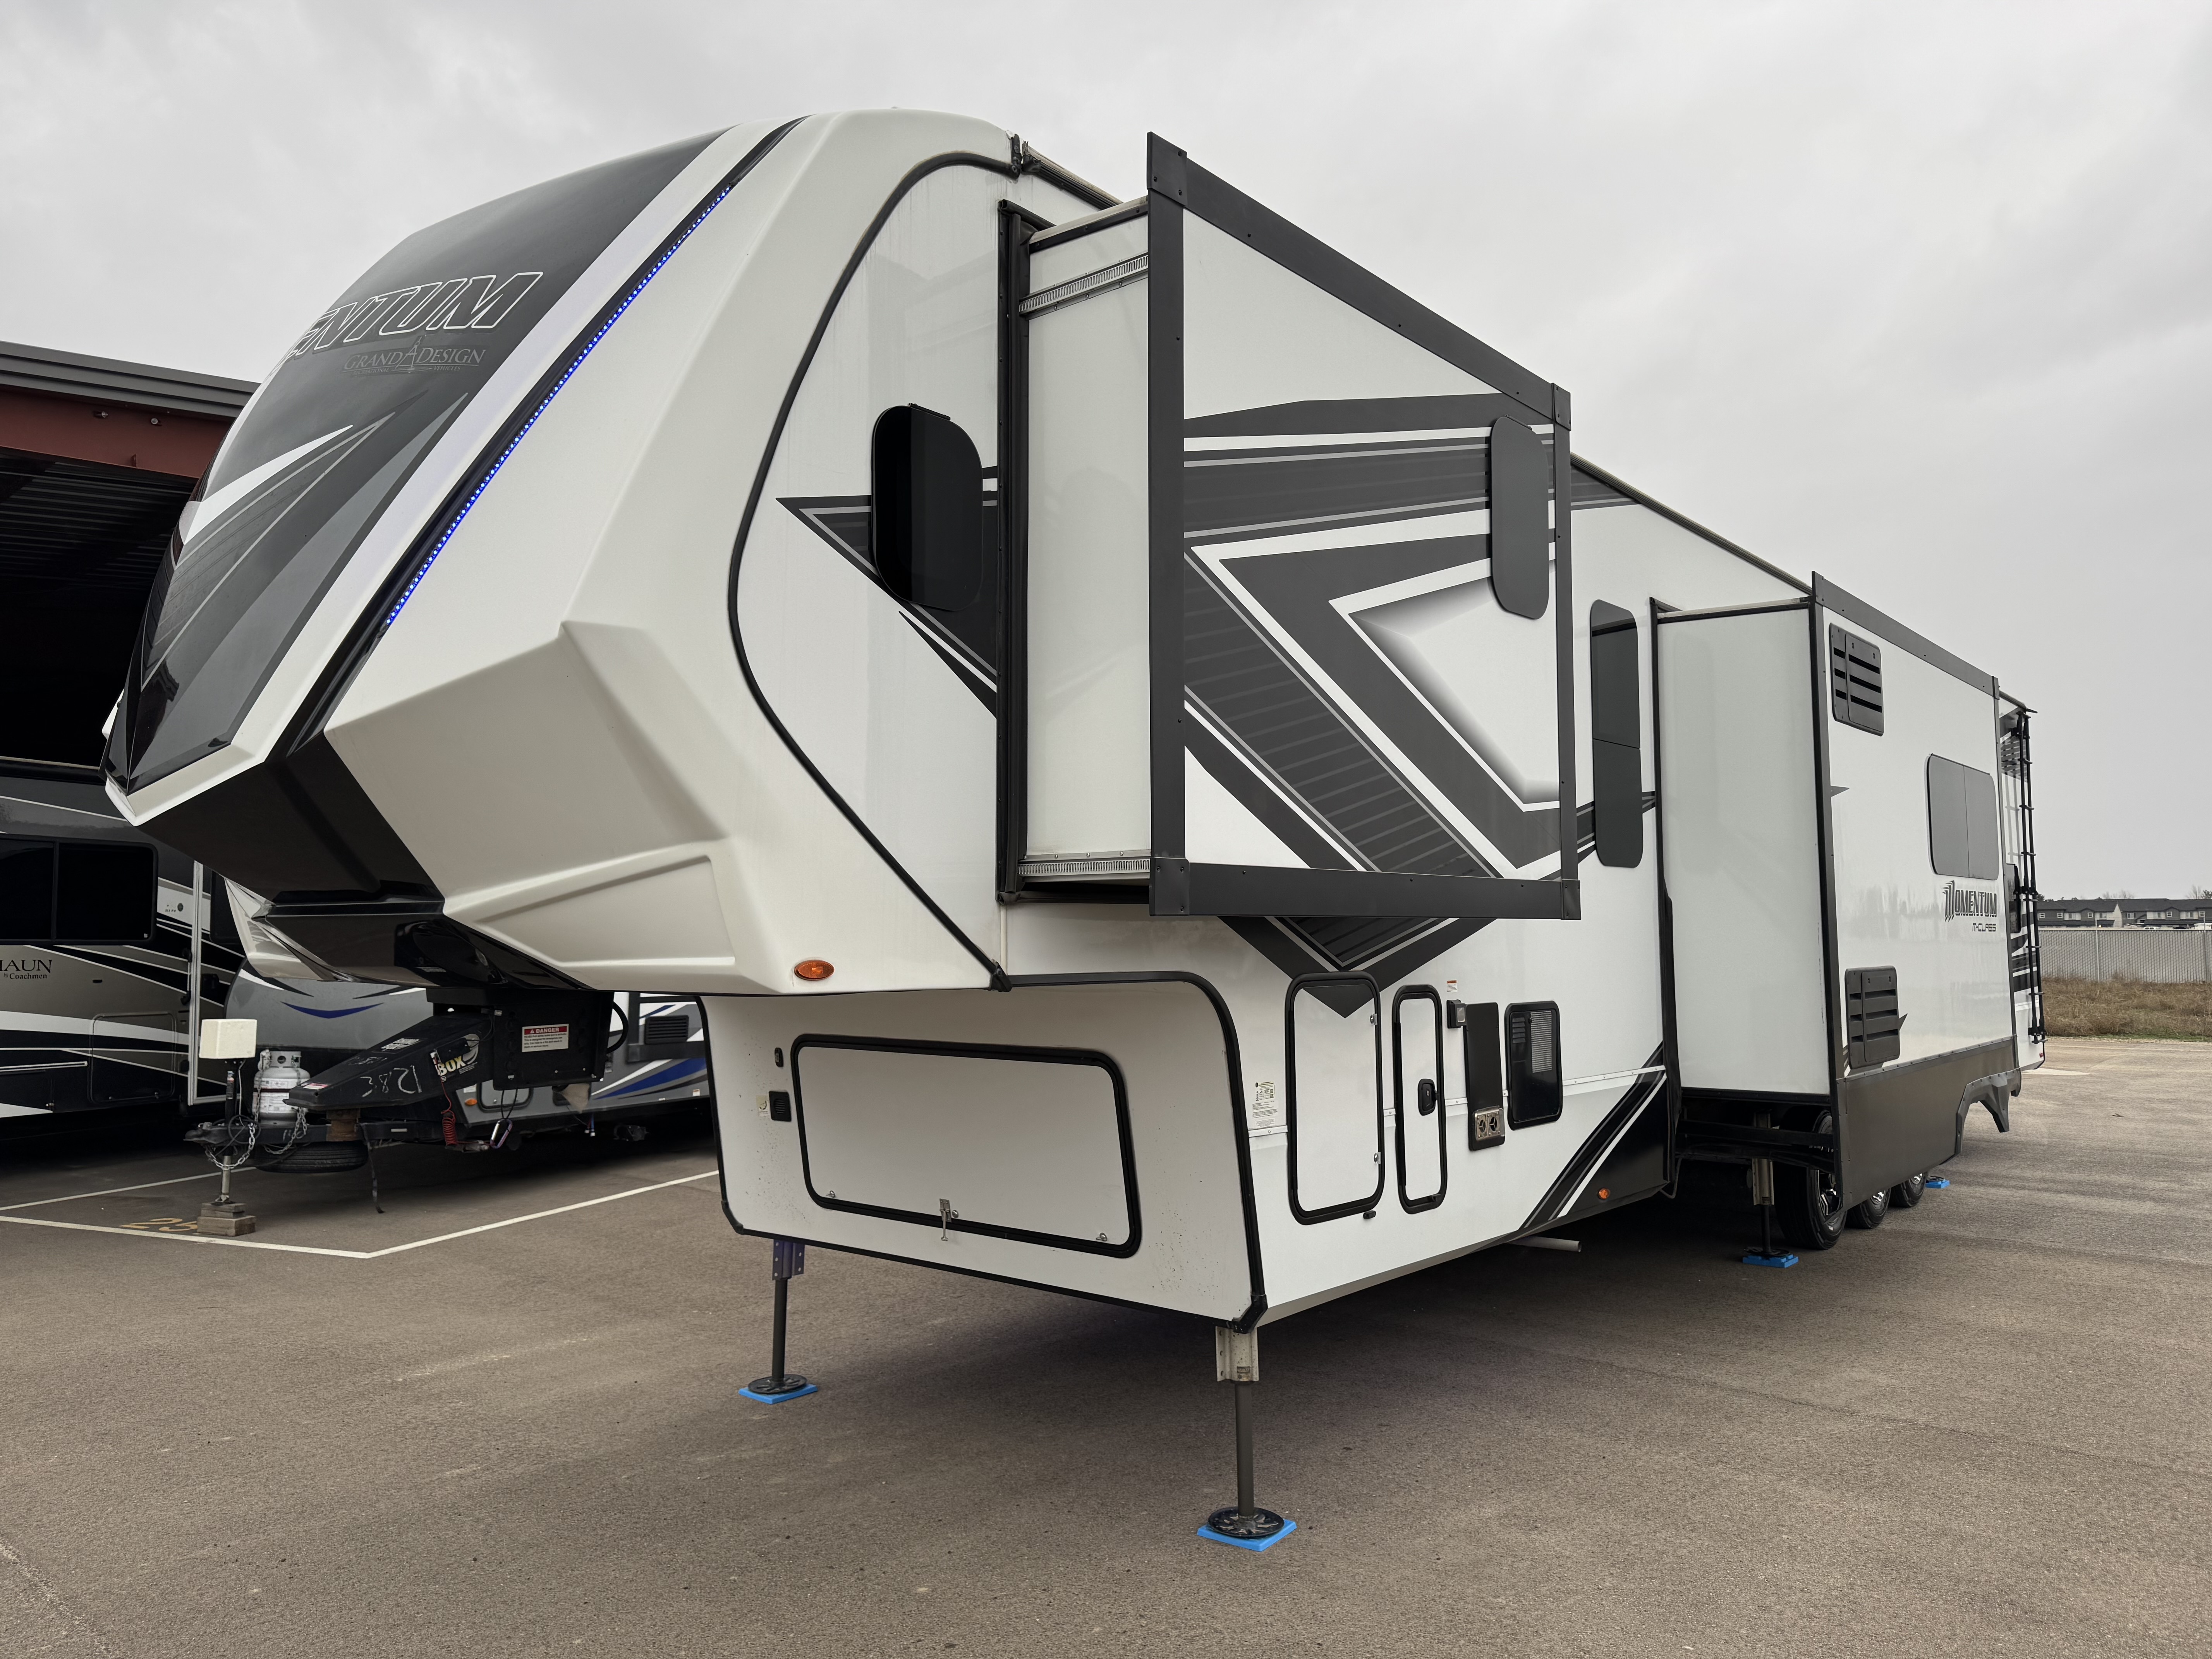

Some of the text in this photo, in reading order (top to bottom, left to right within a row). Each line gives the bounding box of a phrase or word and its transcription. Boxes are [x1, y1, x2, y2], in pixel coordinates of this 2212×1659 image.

[344, 348, 486, 369] GRAND DESIGN
[1941, 880, 1997, 922] MOMENTUM
